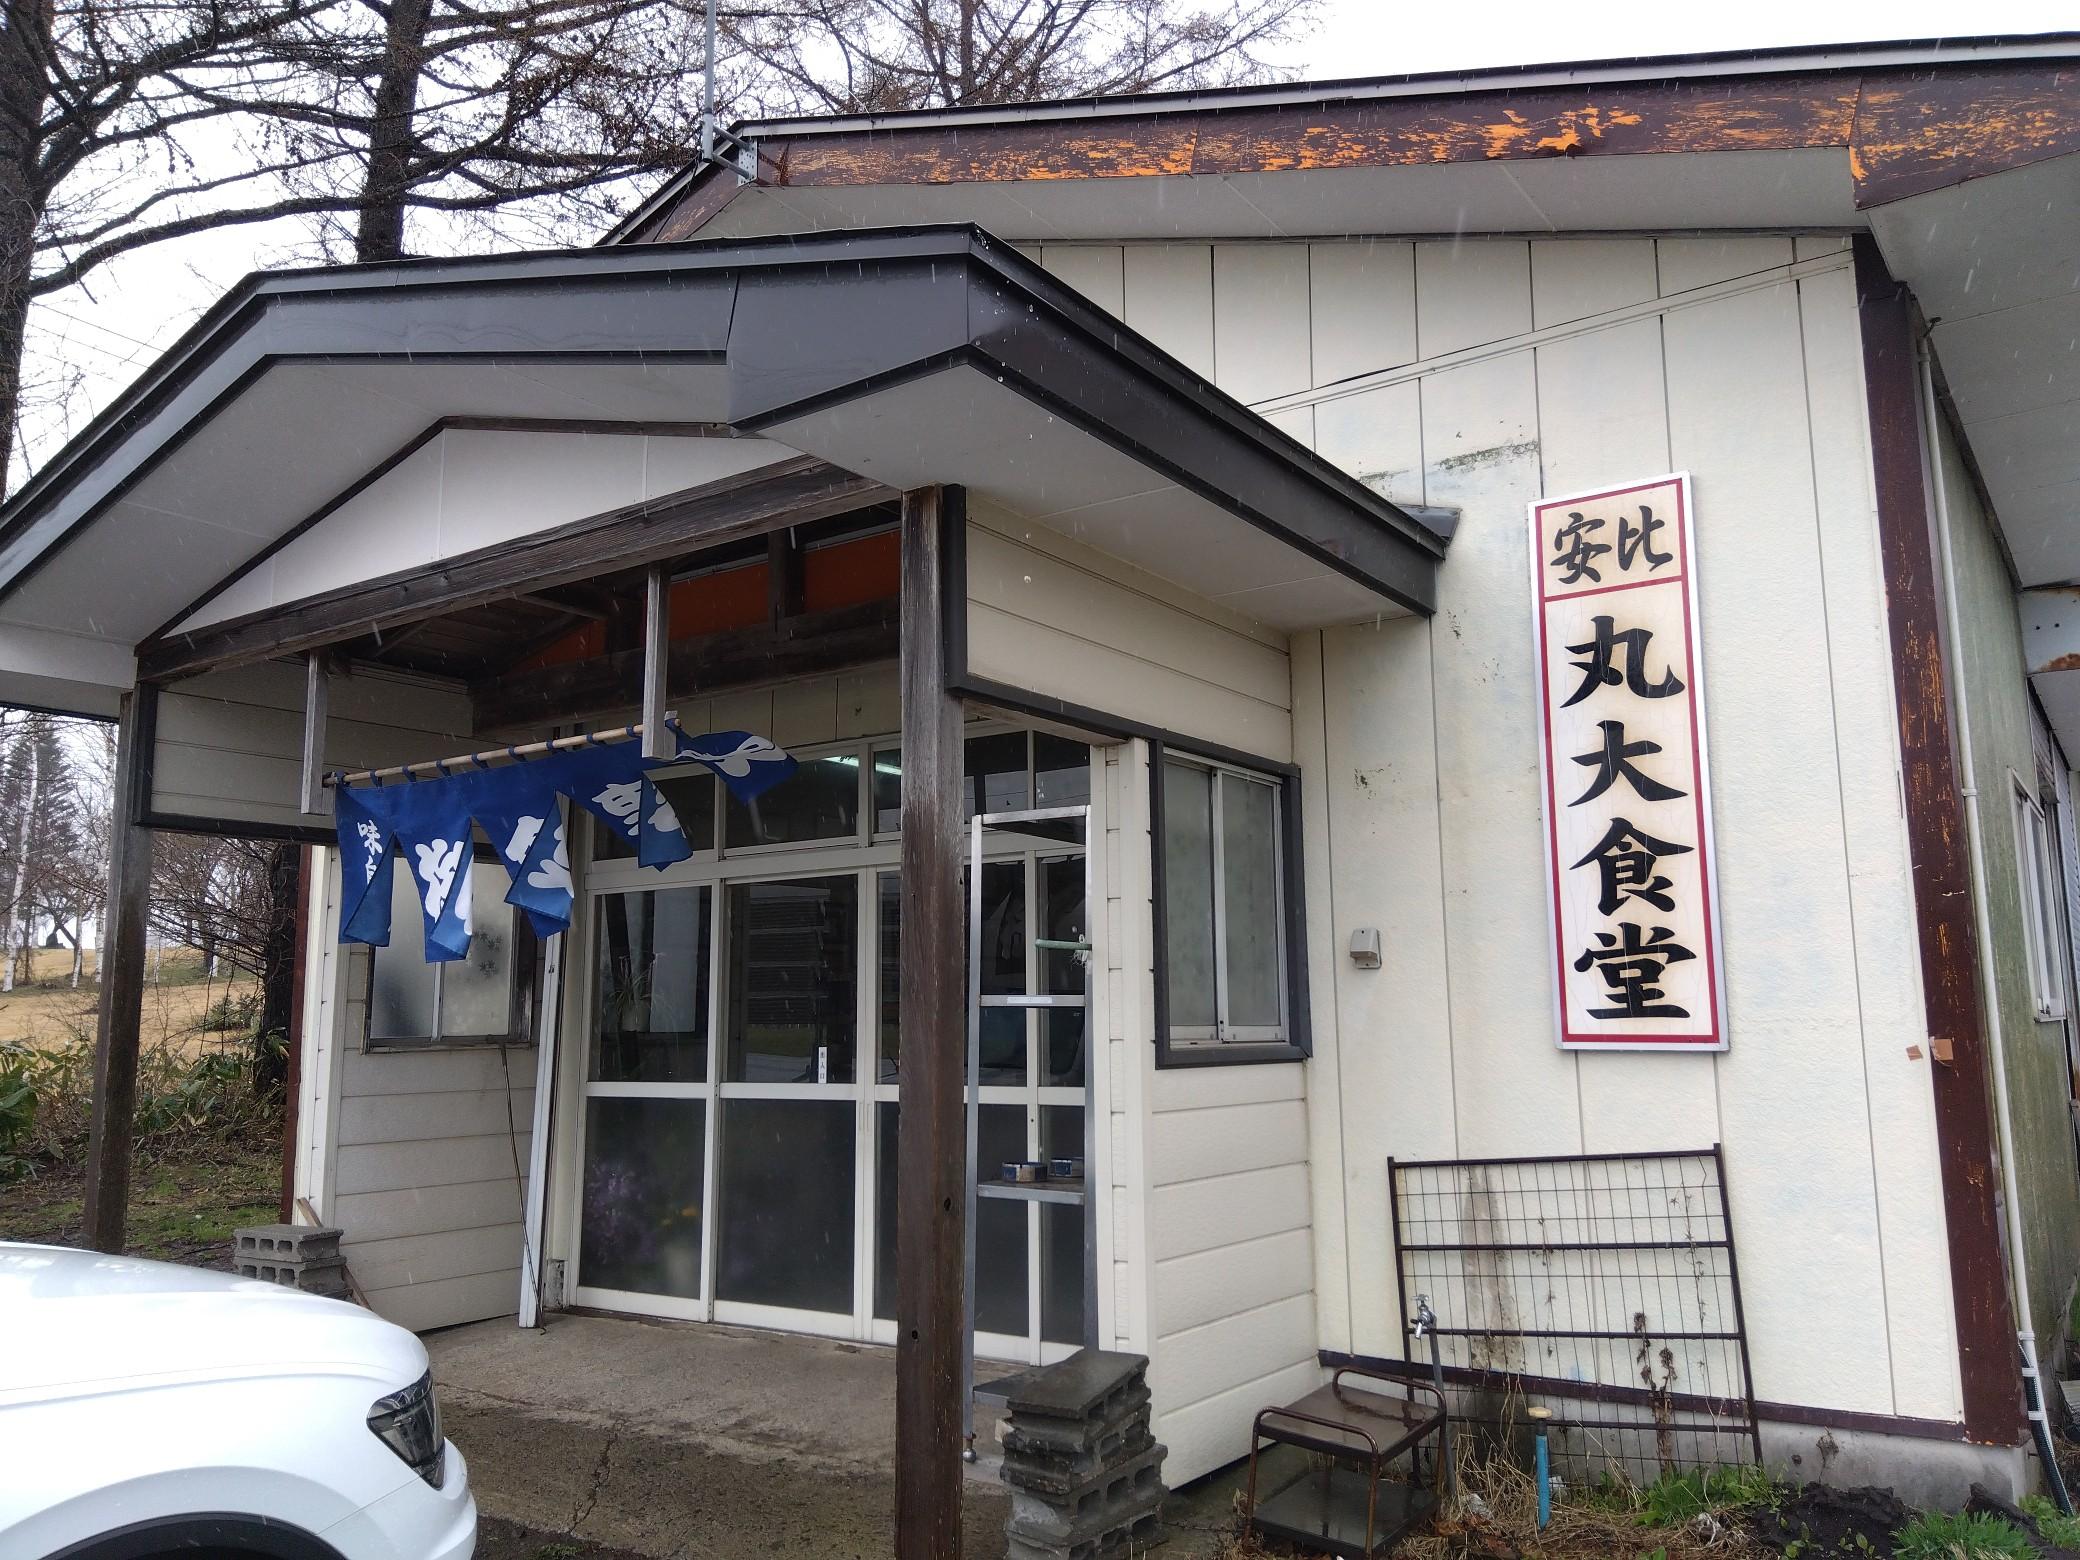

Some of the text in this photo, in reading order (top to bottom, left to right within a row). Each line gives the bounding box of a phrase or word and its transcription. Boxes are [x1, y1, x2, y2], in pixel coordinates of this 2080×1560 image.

[1550, 504, 1675, 584] 安比
[1560, 615, 1697, 1019] 丸大食堂
